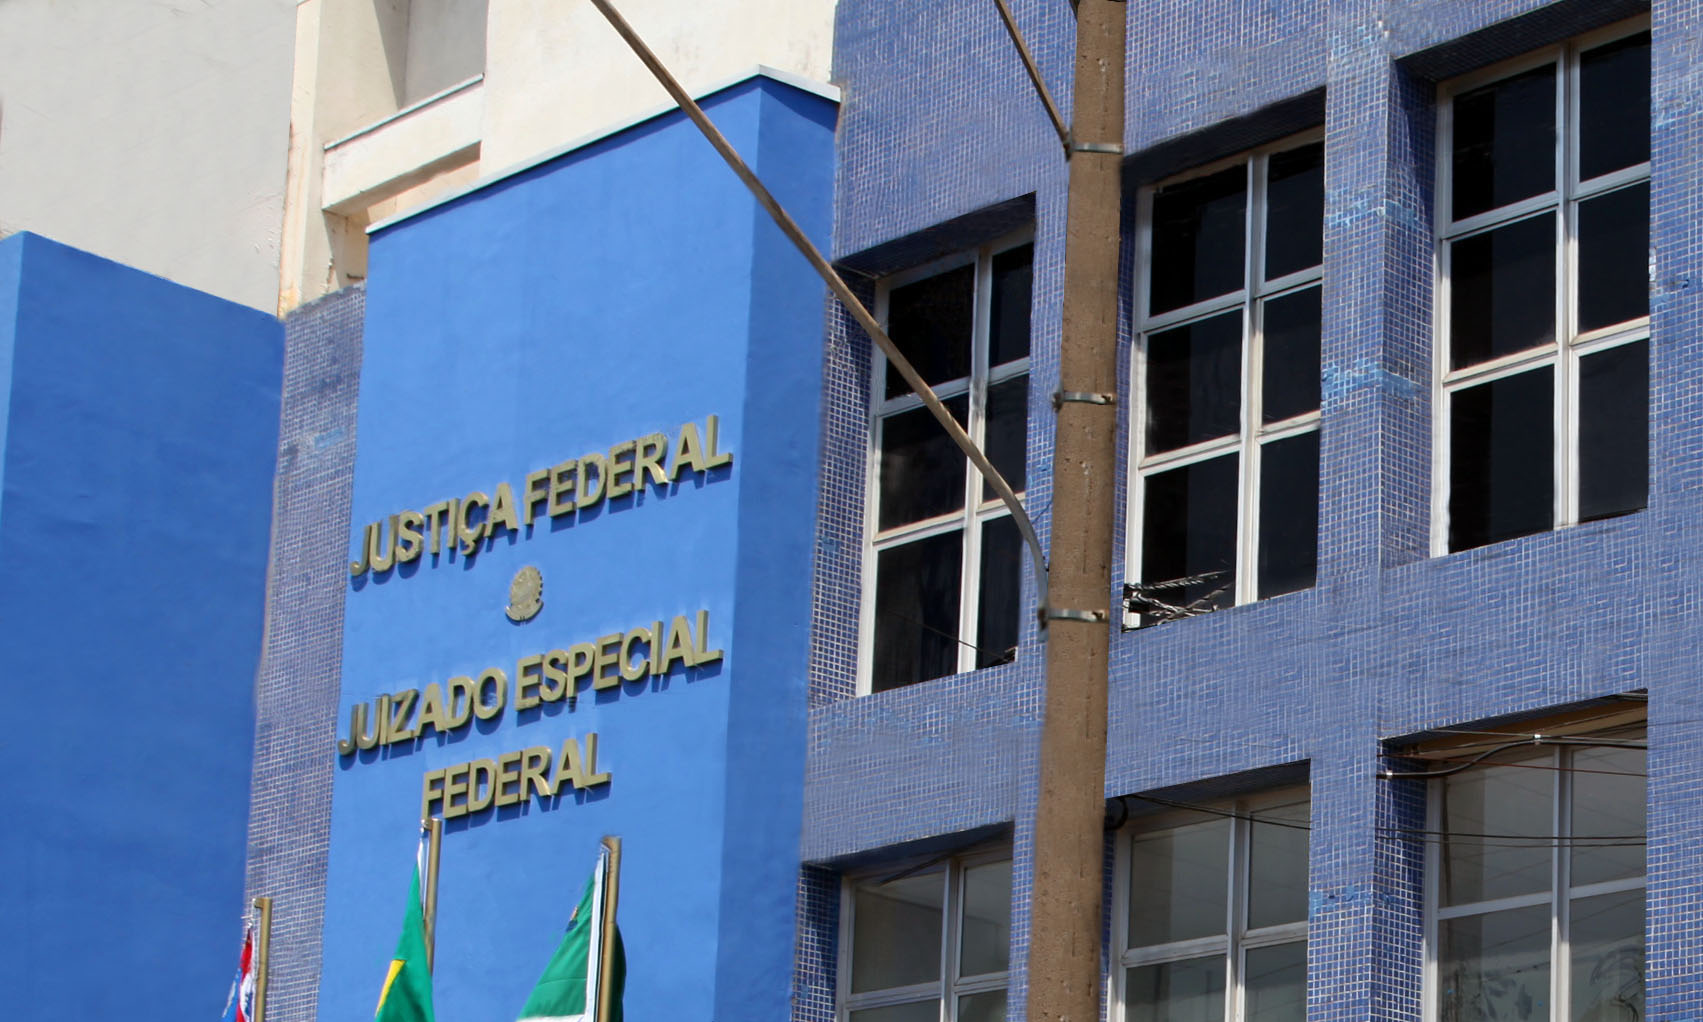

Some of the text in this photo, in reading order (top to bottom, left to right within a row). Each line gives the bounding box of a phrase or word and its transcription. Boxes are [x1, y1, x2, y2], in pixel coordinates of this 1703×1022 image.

[349, 414, 734, 576] JUSTIÇA FEDERAL
[337, 609, 724, 756] JUIZADO ESPECIAL
[421, 732, 612, 820] FEDERAL
